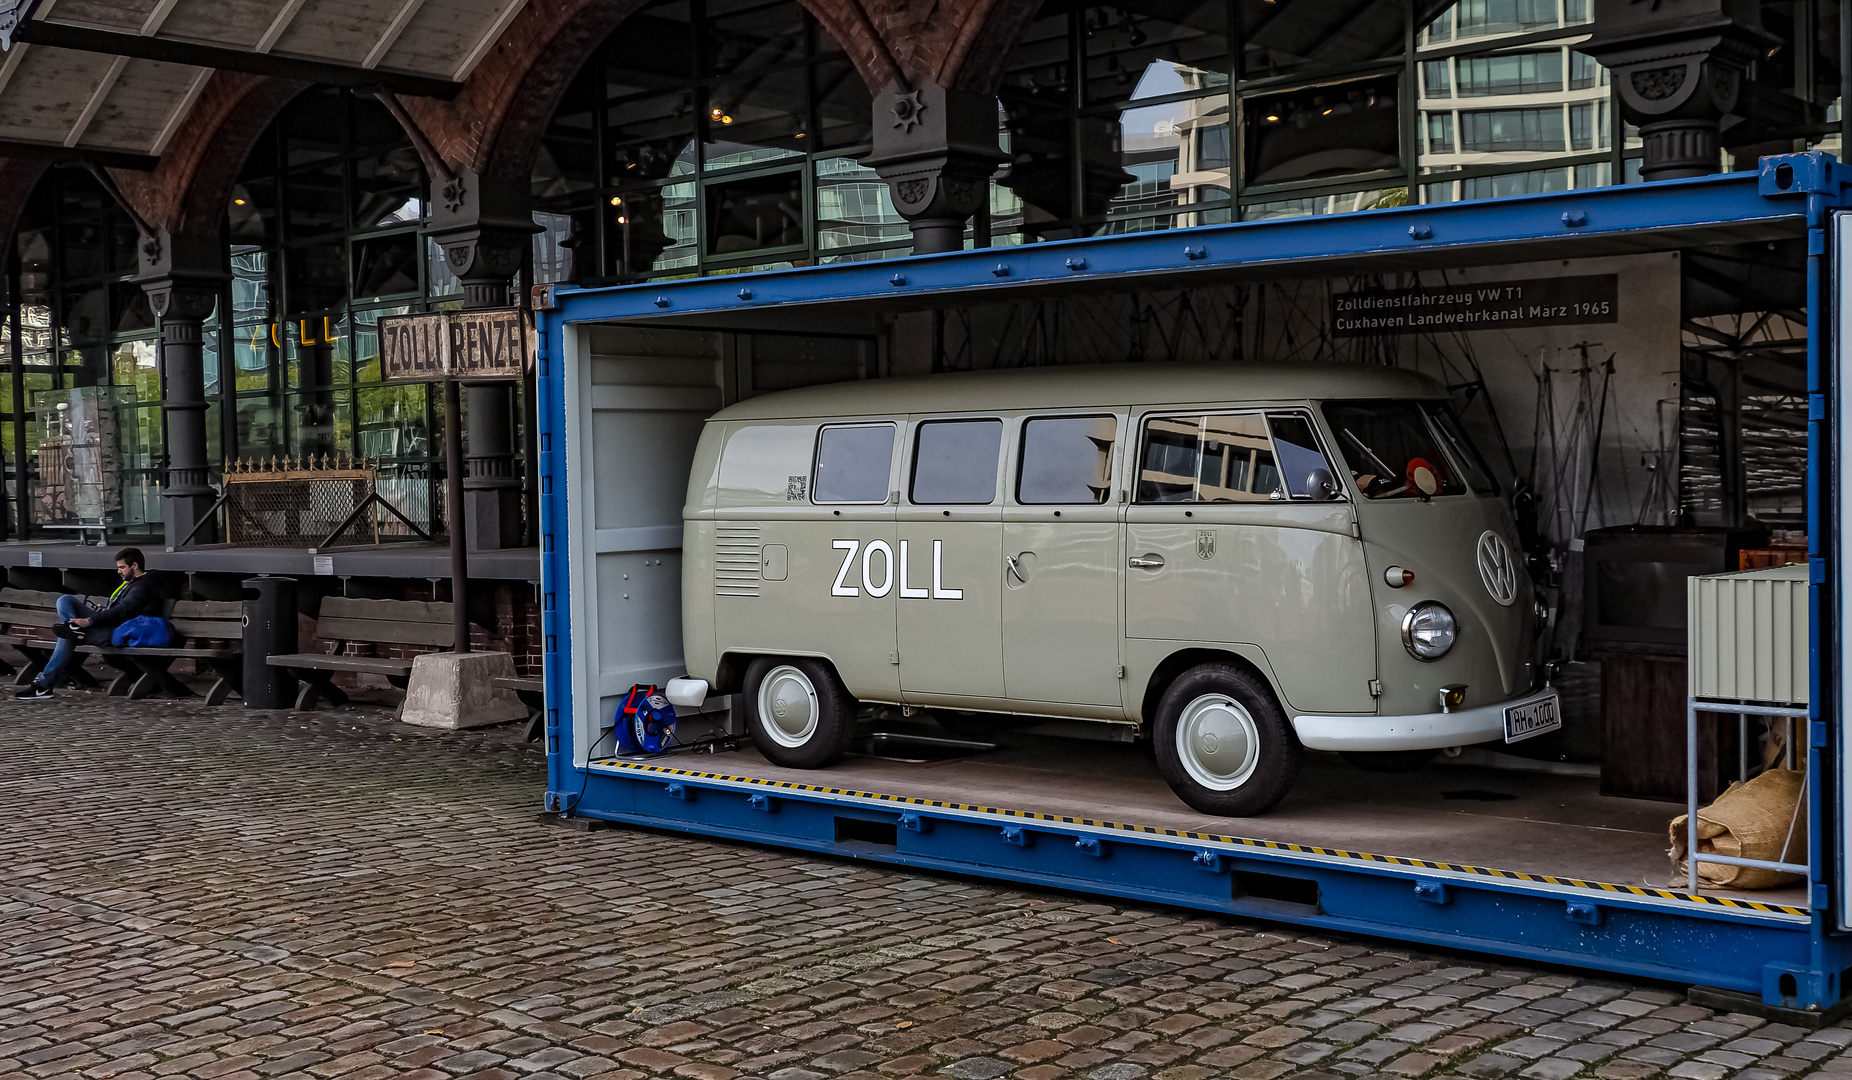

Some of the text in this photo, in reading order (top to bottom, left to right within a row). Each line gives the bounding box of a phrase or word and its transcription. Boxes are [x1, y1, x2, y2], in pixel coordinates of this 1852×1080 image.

[1336, 287, 1522, 311] Zolldienstfahrzeug VW T1
[1336, 301, 1610, 330] Cuxhaven Landwehrkanal März 1965
[831, 539, 963, 600] ZOLL
[1477, 529, 1517, 606] VW
